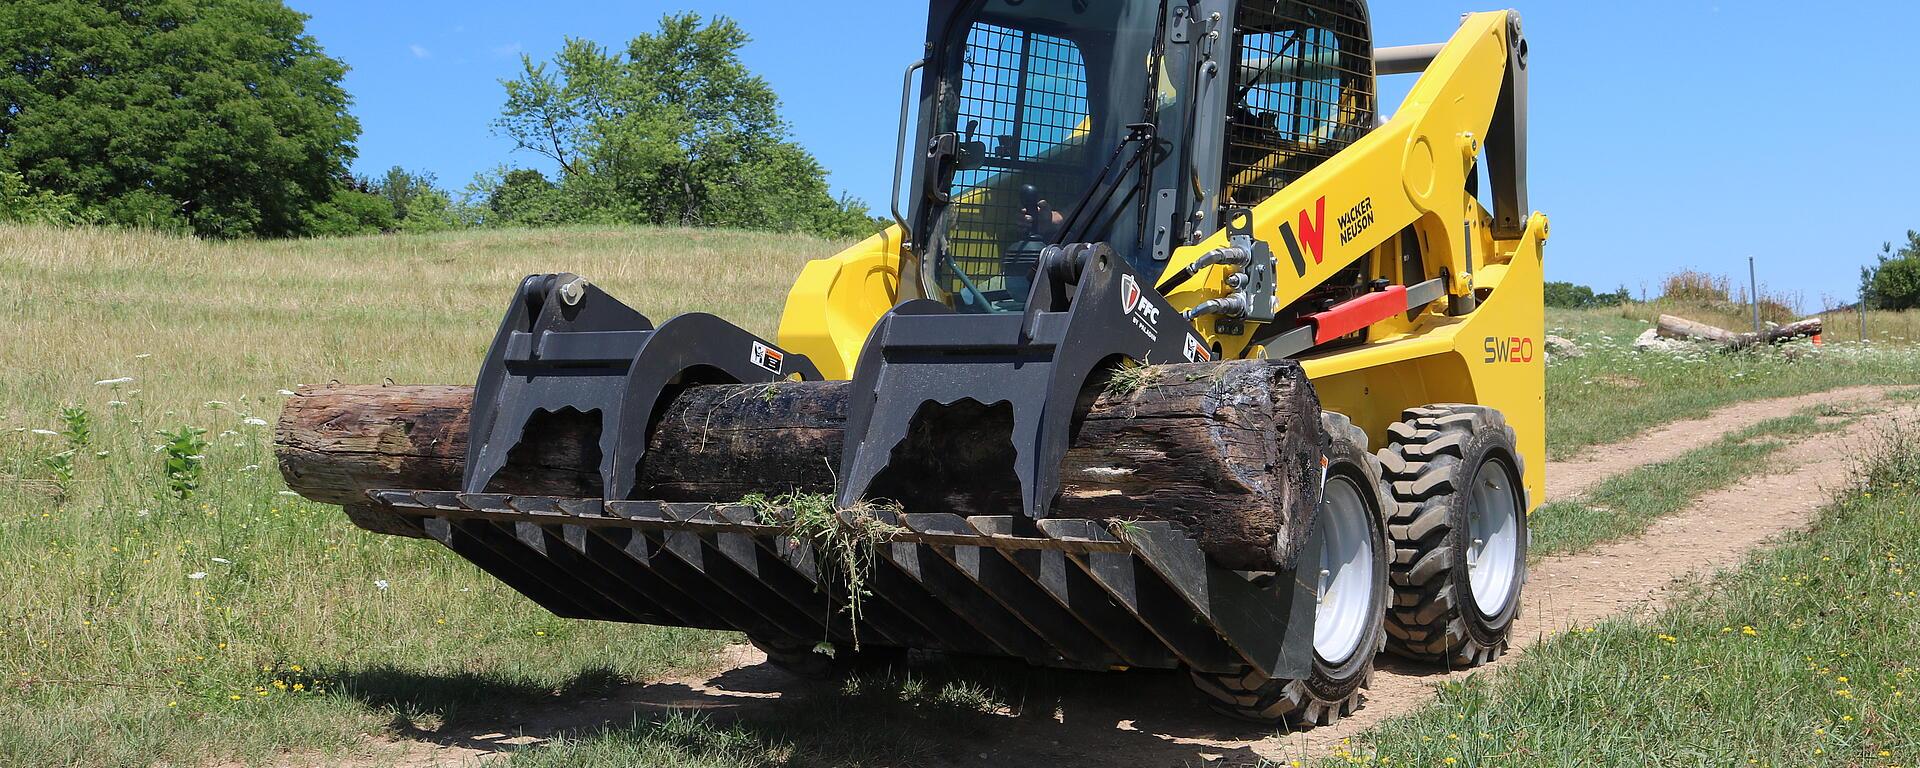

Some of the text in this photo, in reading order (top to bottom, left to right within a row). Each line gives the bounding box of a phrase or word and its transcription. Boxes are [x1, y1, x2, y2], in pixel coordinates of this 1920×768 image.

[1337, 196, 1373, 230] WACKER
[1339, 210, 1374, 246] NEUSON
[1137, 295, 1160, 325] FFC
[1484, 336, 1533, 363] SW20
